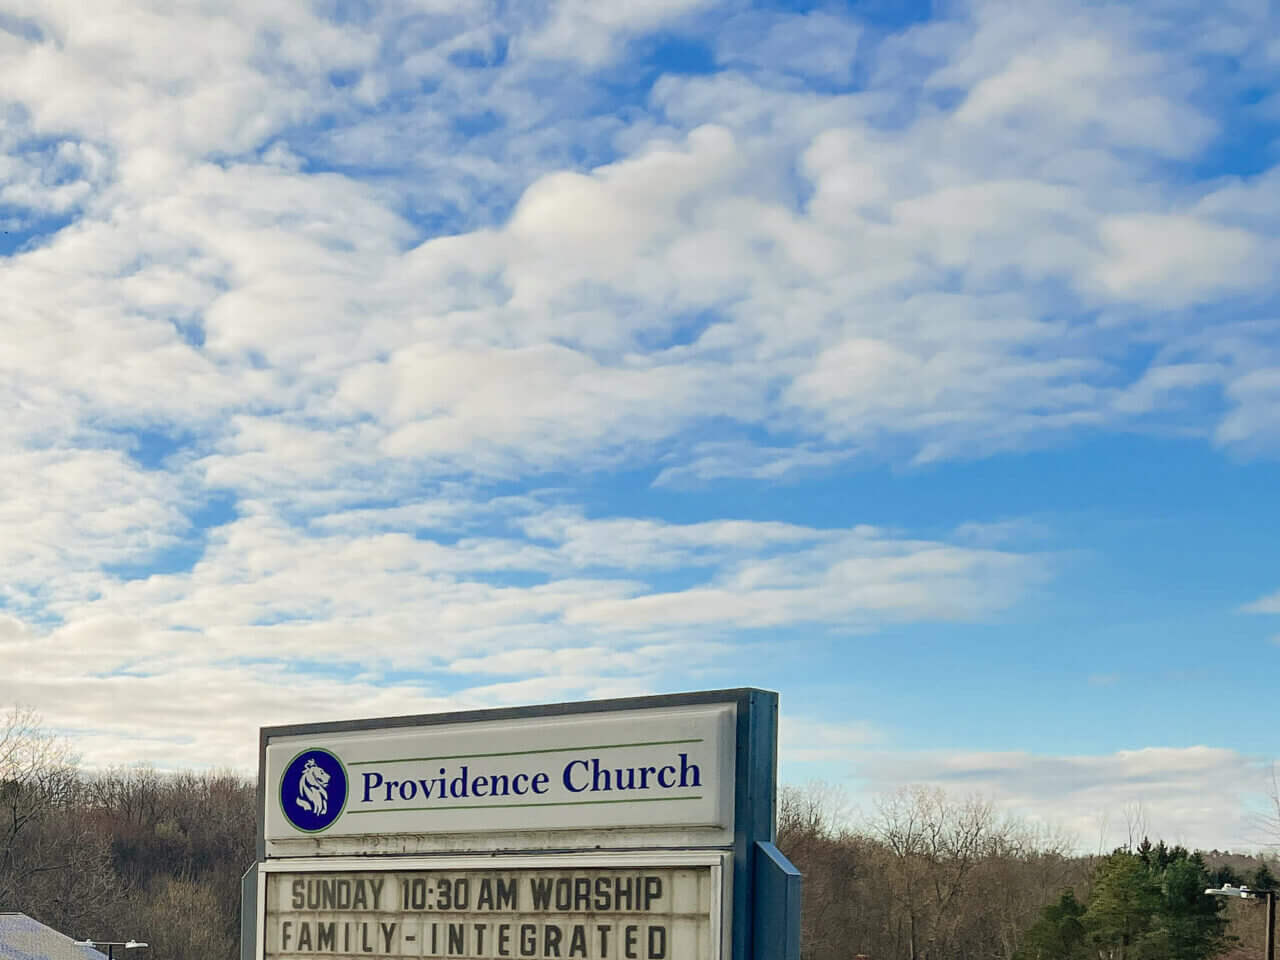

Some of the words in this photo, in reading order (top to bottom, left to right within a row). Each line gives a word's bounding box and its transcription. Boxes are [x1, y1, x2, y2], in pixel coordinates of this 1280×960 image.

[361, 766, 549, 802] Providence
[563, 753, 702, 793] Church
[292, 879, 384, 910] SUNDAY
[403, 878, 468, 910] 10:30
[477, 878, 517, 910] AM
[530, 876, 662, 911] WORSHIP
